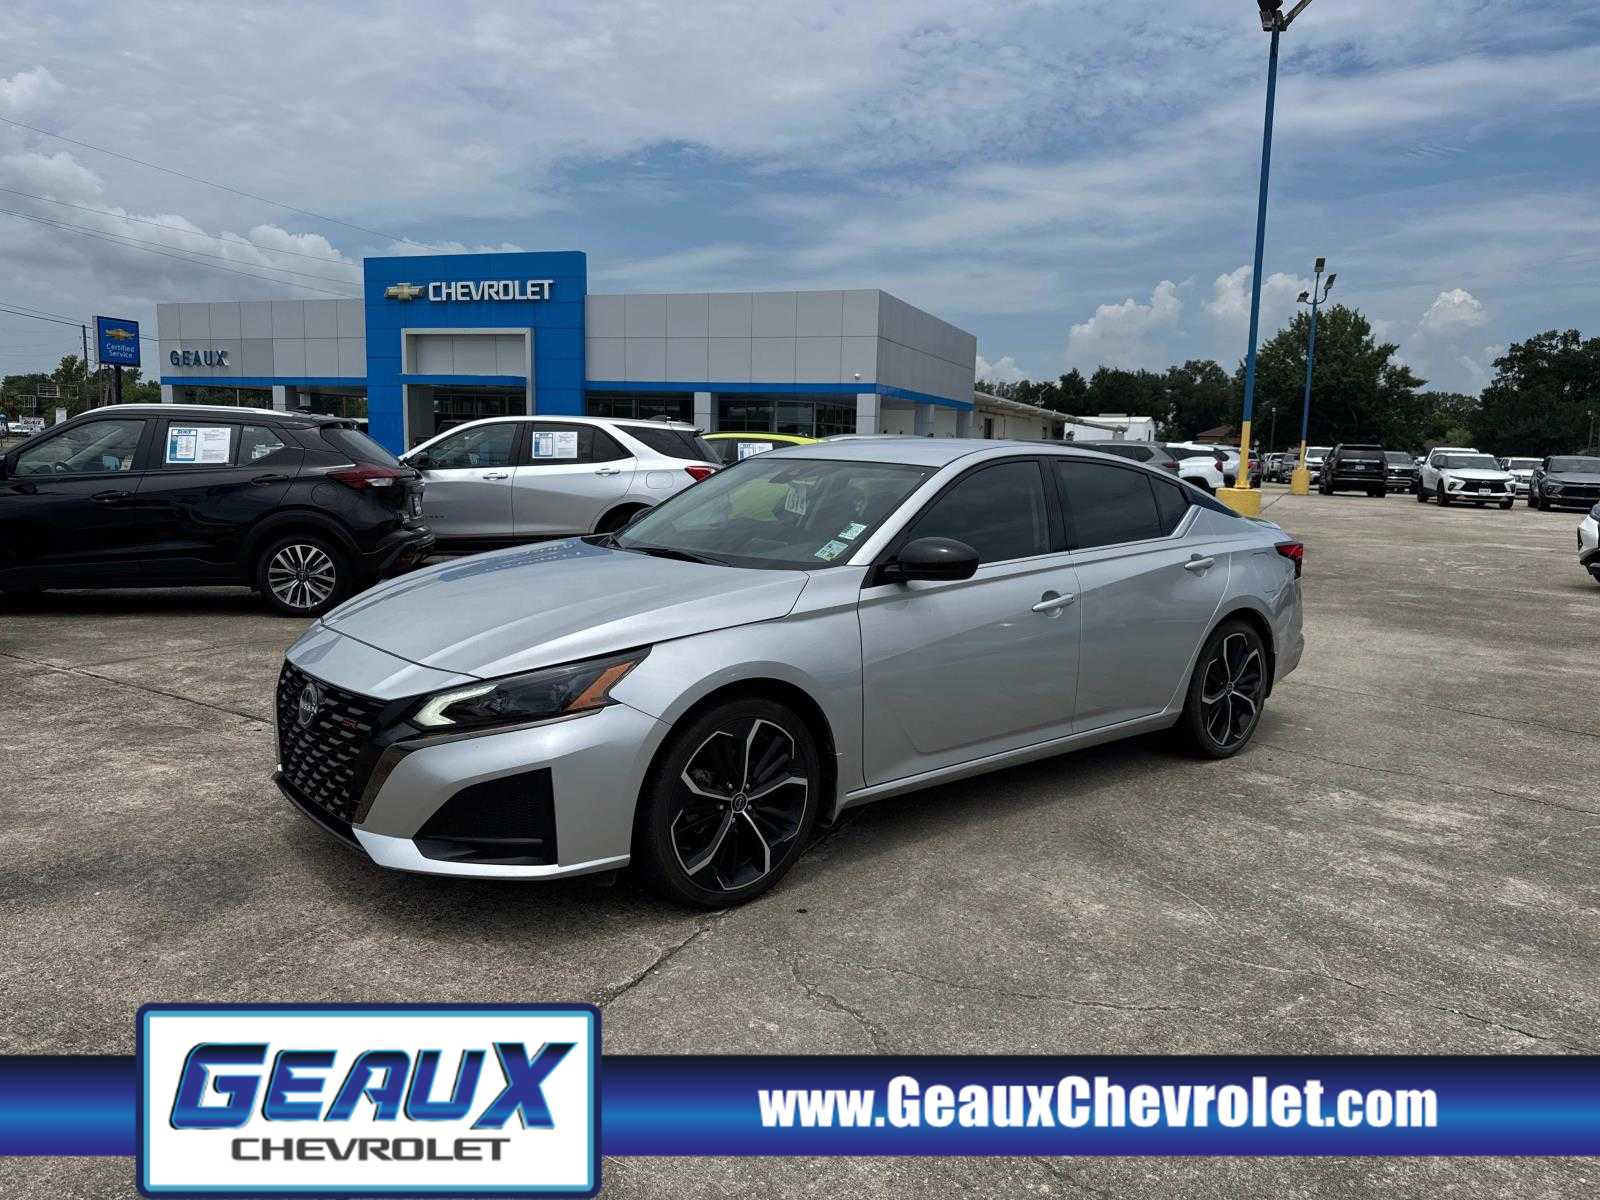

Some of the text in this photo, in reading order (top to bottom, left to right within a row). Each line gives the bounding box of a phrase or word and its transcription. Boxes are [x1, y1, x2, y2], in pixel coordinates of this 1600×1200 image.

[428, 279, 554, 302] CHEVROLET
[106, 343, 135, 353] Certified
[109, 350, 133, 359] Service
[169, 350, 228, 367] GEAUX
